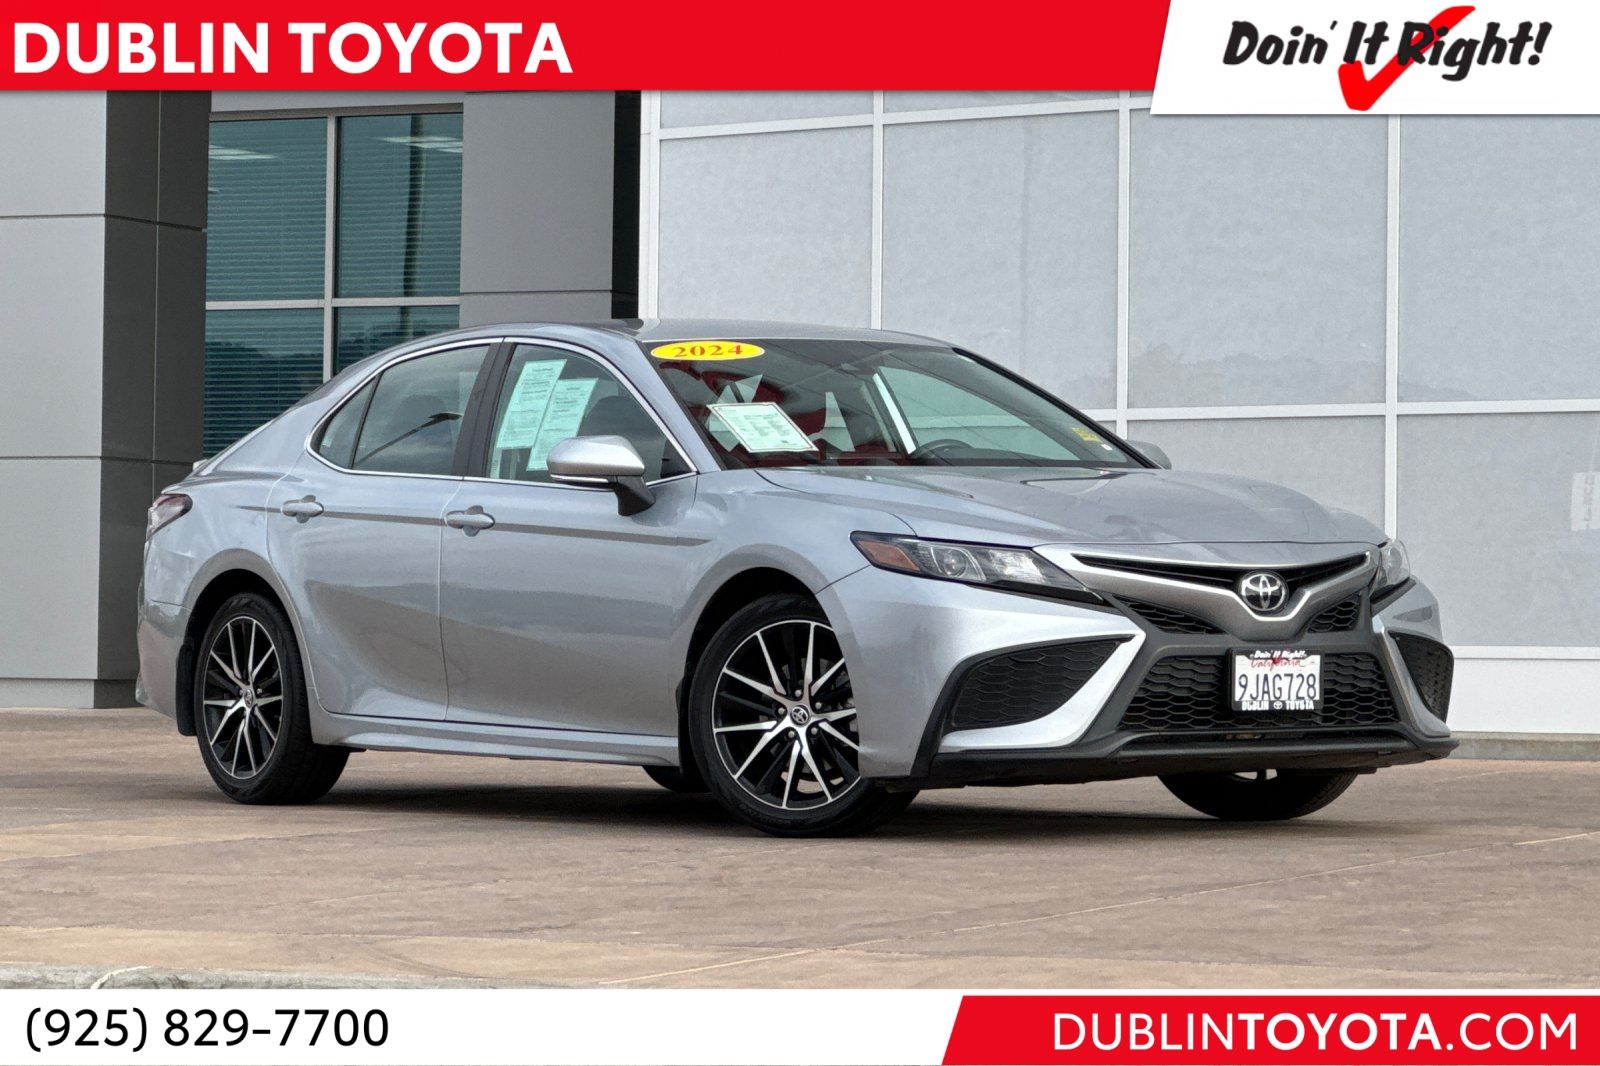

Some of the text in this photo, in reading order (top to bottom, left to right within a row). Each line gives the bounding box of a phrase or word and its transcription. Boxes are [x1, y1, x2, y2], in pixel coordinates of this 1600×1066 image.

[672, 345, 743, 358] 2024
[1238, 673, 1317, 701] 9JAG728
[1241, 700, 1315, 711] DUBLIN TOYOTA
